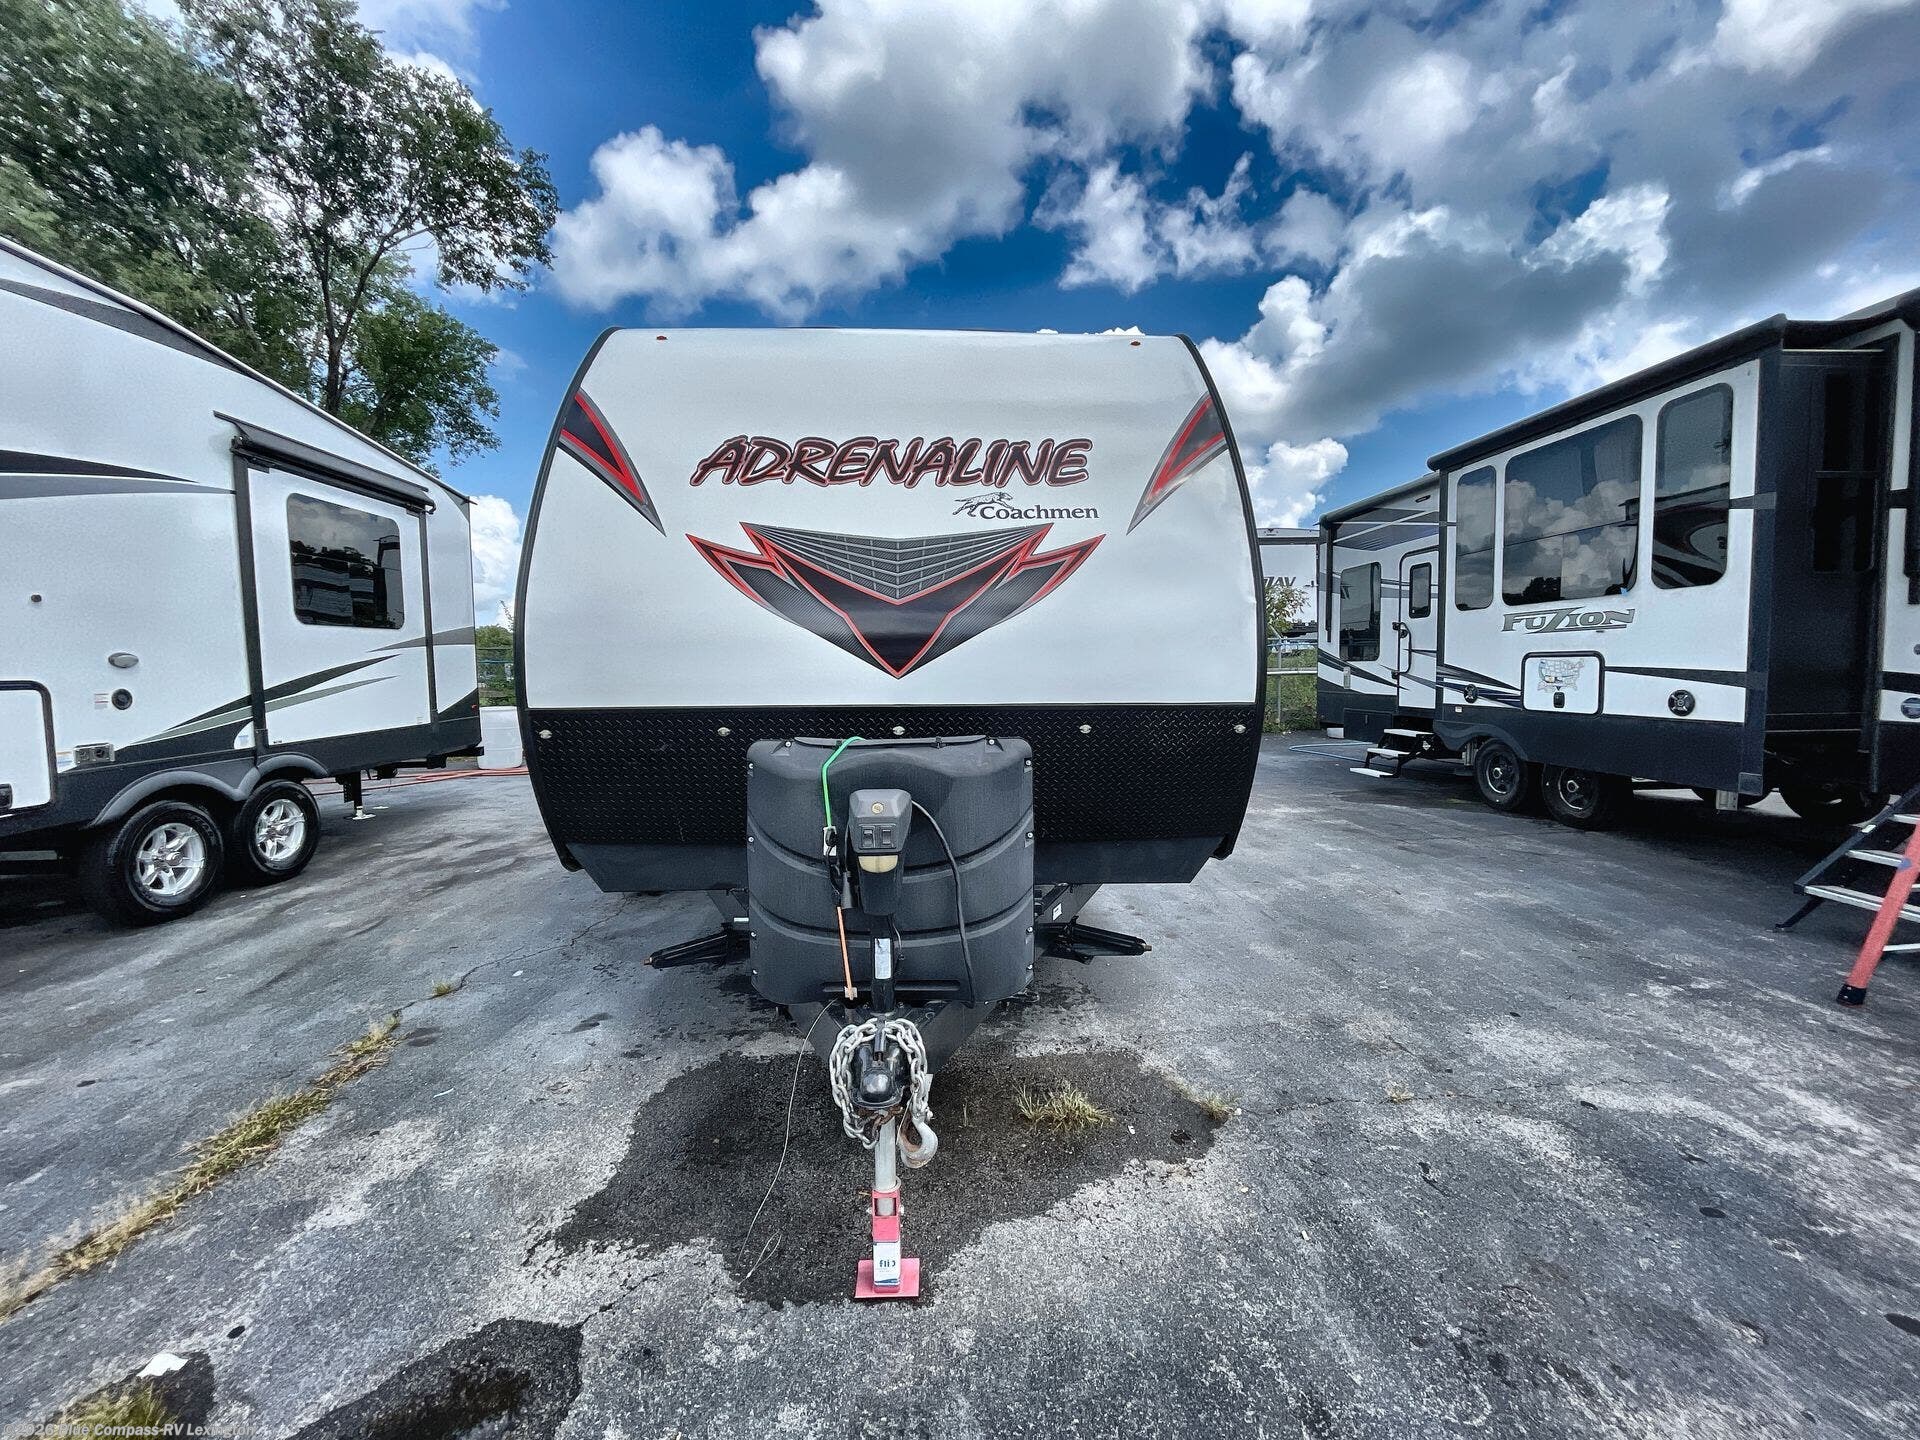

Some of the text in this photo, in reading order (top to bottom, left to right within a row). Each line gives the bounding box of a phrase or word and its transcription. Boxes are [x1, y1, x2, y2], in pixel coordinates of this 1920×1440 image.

[690, 435, 1093, 488] ADRENALINE
[979, 503, 1099, 520] Coachmen
[1501, 606, 1636, 634] FUZION
